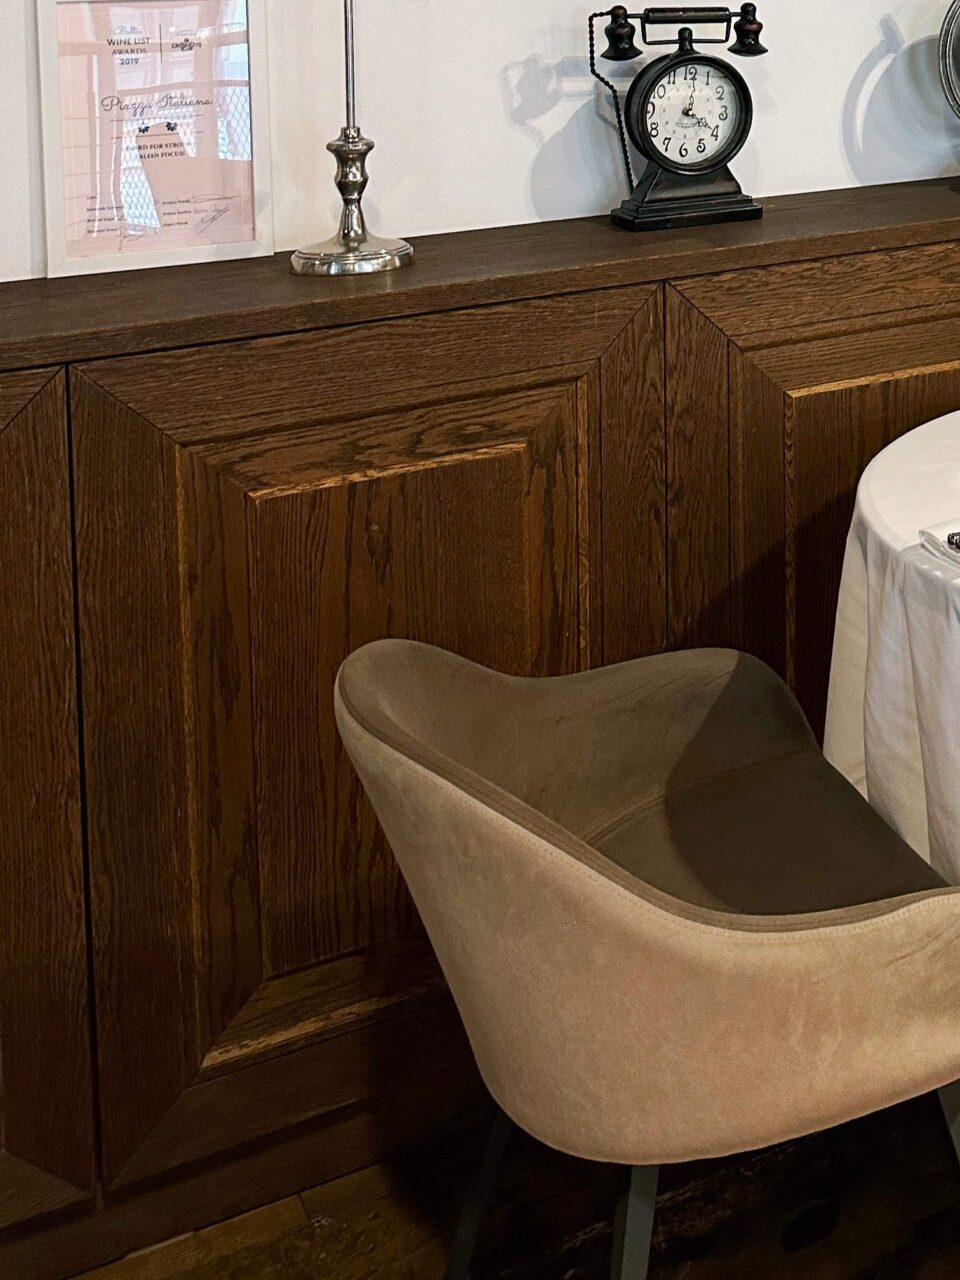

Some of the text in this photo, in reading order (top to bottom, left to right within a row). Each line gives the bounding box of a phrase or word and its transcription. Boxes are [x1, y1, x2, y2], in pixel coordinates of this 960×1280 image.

[107, 37, 150, 46] WINE LIST
[111, 48, 147, 56] AWARDS
[119, 58, 140, 66] 2019
[667, 69, 678, 85] 11
[683, 66, 698, 81] 12
[705, 71, 711, 86] 1
[652, 84, 667, 100] 10
[715, 85, 725, 101] 2
[101, 93, 214, 118] Piazza Italiana
[647, 101, 656, 120] 9
[718, 105, 728, 121] 3
[649, 122, 659, 138] 8
[710, 124, 720, 141] 4
[662, 136, 672, 153] 7
[679, 142, 689, 158] 6
[696, 138, 706, 153] 5
